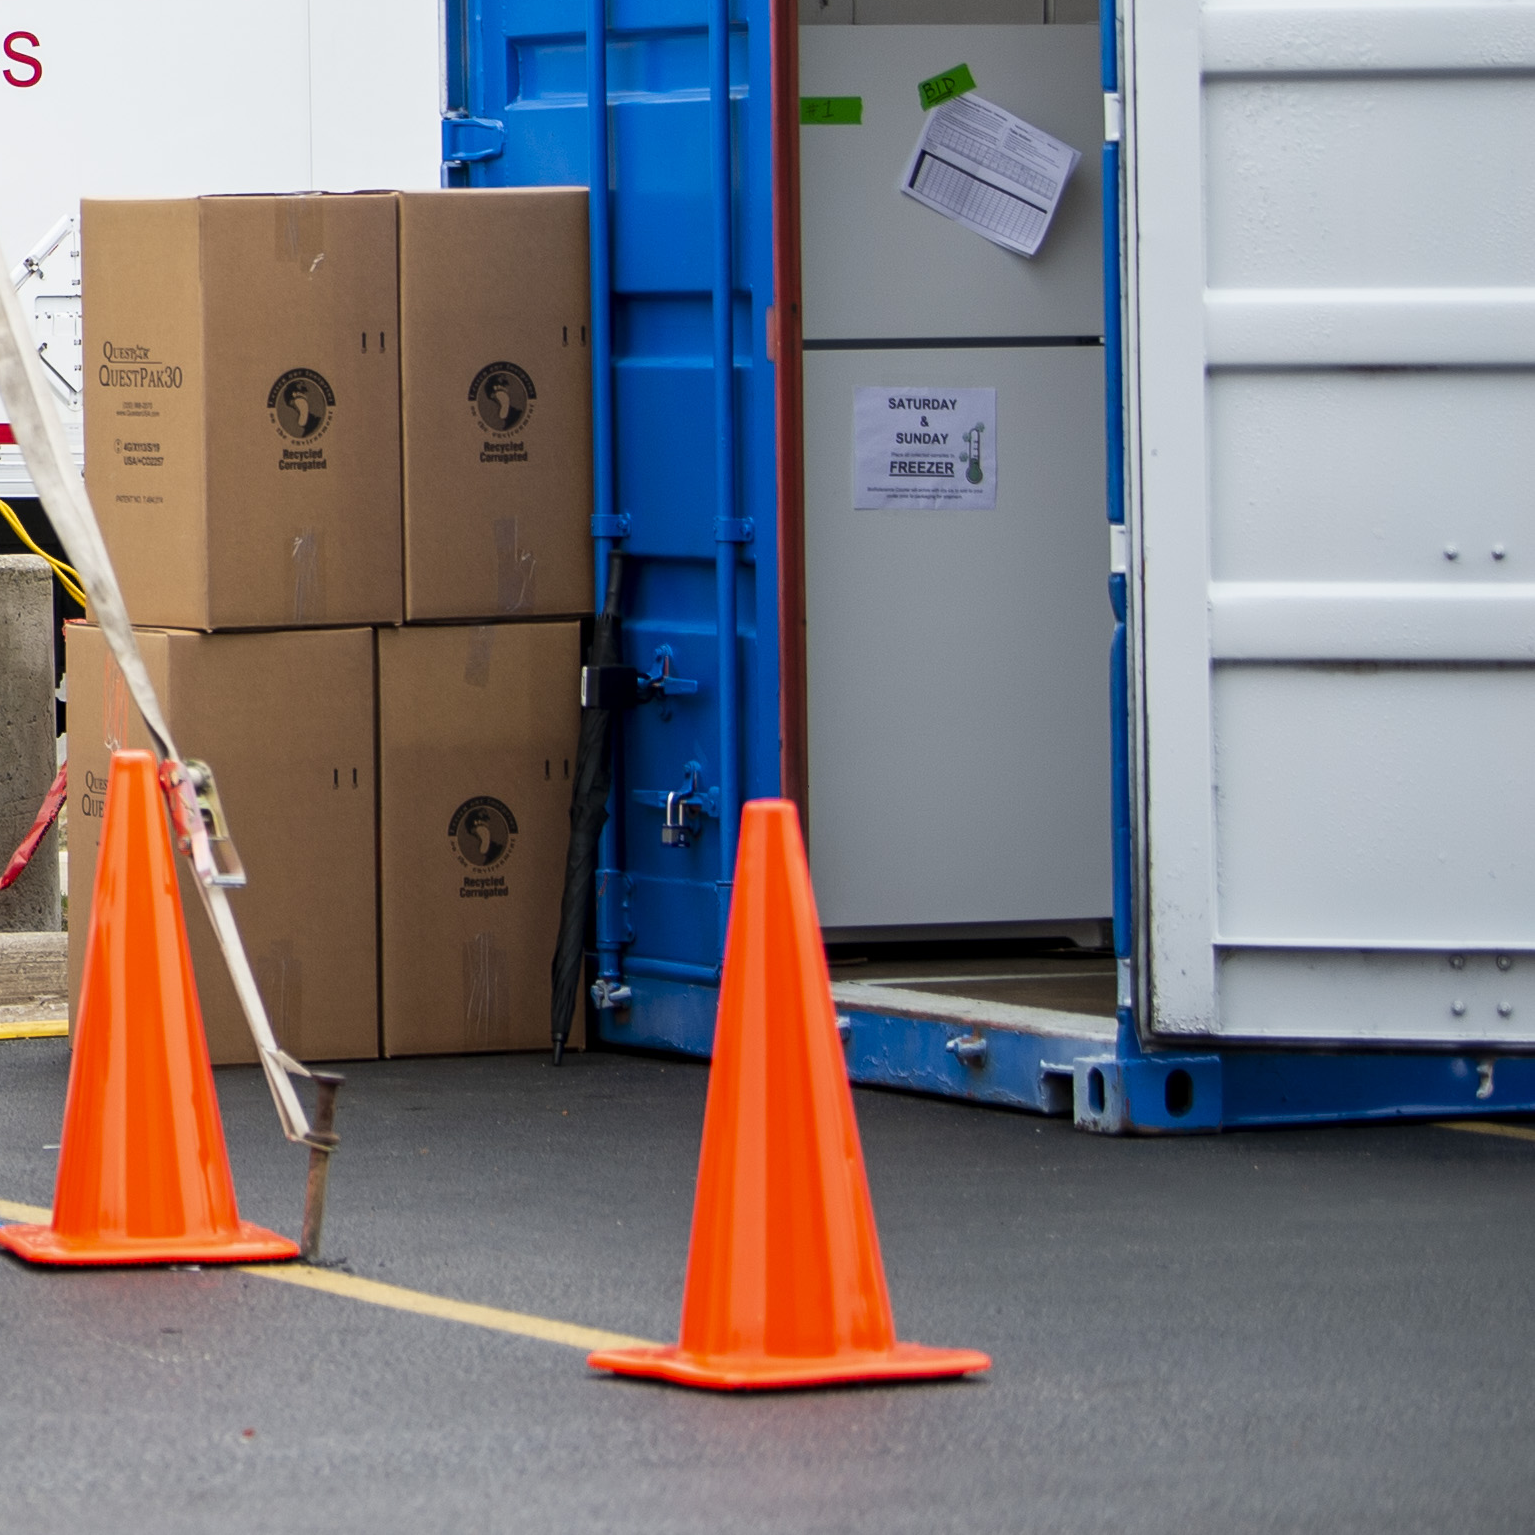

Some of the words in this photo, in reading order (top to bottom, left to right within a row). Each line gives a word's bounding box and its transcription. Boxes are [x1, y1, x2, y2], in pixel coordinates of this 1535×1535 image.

[805, 99, 835, 119] #1
[98, 364, 183, 389] QUESTPAK30
[888, 398, 957, 411] SATURDAY
[919, 415, 929, 427] &
[895, 432, 949, 445] SUNDAY
[484, 441, 524, 453] Recycled
[282, 449, 323, 462] Recycled
[479, 451, 528, 464] Corrugated
[278, 459, 327, 472] Corrugated
[889, 461, 955, 476] FREEZER
[464, 876, 505, 888] Recycled
[460, 886, 508, 899] Corrugated
